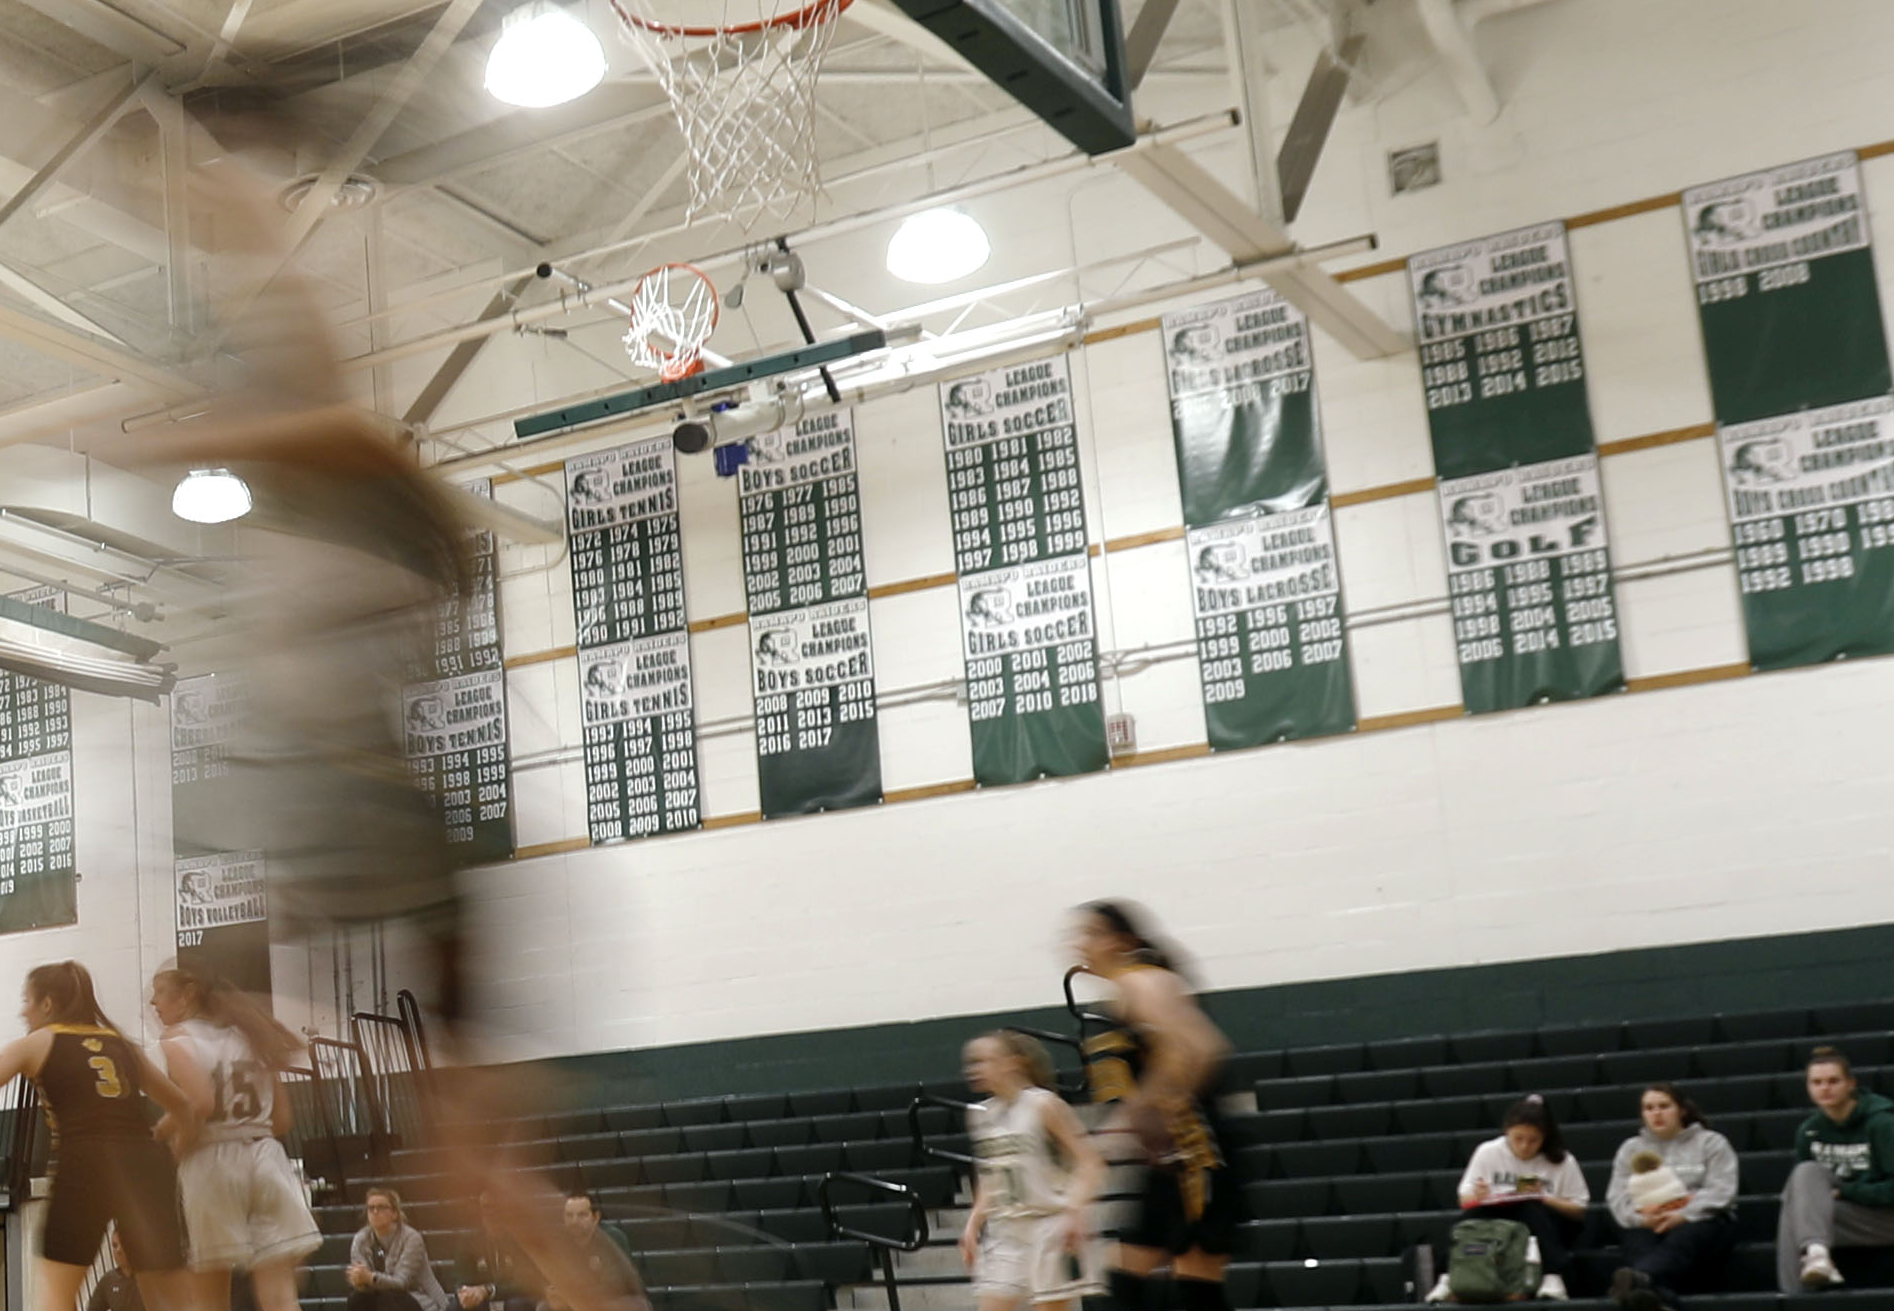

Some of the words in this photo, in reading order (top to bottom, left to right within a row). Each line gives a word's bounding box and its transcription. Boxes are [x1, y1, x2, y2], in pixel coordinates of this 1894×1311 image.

[1422, 283, 1567, 339] GYMNASTICS
[1006, 363, 1052, 388] LEAGUE
[996, 378, 1066, 408] CHAMPIONS
[796, 413, 837, 436] LEAGUE
[948, 422, 998, 445] GIRLS
[1004, 398, 1067, 433] SOCCER
[787, 428, 850, 456] CHAMPIONS
[992, 438, 1028, 460] 1981
[1037, 428, 1073, 450] 1982
[622, 455, 661, 476] LEAGUE
[743, 468, 784, 491] BOYS
[791, 447, 851, 481] SOCCER
[950, 468, 984, 490] 1983
[994, 458, 1030, 480] 1984
[613, 469, 673, 495] CHAMPIONS
[782, 484, 814, 505] 1977
[571, 507, 615, 530] GIRLS
[620, 488, 674, 521] TENNIS
[784, 504, 816, 525] 1989
[824, 495, 856, 516] 1990
[572, 532, 601, 551] 1972
[610, 524, 639, 543] 1974
[647, 516, 676, 535] 1975
[745, 532, 777, 553] 1991
[1262, 528, 1315, 551] LEAGUE
[1450, 516, 1598, 565] GOLF
[611, 543, 640, 562] 1978
[1251, 544, 1331, 573] CHAMPIONS
[1027, 575, 1075, 597] LEAGUE
[1197, 588, 1240, 612] BOYS
[1247, 564, 1331, 603] LACROSSE
[1016, 592, 1088, 618] CHAMPIONS
[1197, 615, 1237, 638] 1992
[1297, 597, 1336, 620] 1997
[812, 617, 856, 638] LEAGUE
[968, 629, 1019, 654] GIRLS
[1025, 610, 1088, 645] SOCCER
[802, 632, 867, 658] CHAMPIONS
[636, 650, 676, 670] LEAGUE
[758, 668, 799, 691] BOYS
[806, 651, 868, 683] SOCCER
[968, 657, 1002, 679] 2000
[1012, 649, 1047, 671] 2001
[1057, 641, 1092, 663] 2002
[1202, 658, 1242, 681] 2003
[1301, 640, 1343, 665] 2007
[627, 665, 687, 690] CHAMPIONS
[969, 677, 1004, 700] 2003
[16, 689, 37, 706] 1983
[455, 687, 492, 707] LEAGUE
[586, 701, 628, 722] GIRLS
[633, 683, 688, 715] TENNIS
[447, 701, 502, 725] CHAMPIONS
[758, 714, 789, 735] 2011
[798, 707, 831, 728] 2013
[840, 700, 874, 722] 2015
[407, 733, 445, 755] BOYS
[449, 718, 502, 748] TENNIS
[585, 725, 614, 745] 1993
[623, 718, 653, 737] 1994
[661, 710, 691, 730] 1995
[442, 752, 470, 770] 1994
[476, 746, 504, 764] 1995
[586, 744, 616, 764] 1996
[759, 734, 791, 756] 2016
[32, 767, 61, 784] LEAGUE
[443, 771, 470, 789] 1998
[477, 764, 505, 783] 1999
[24, 780, 69, 800] CHAMPIONS
[19, 825, 43, 842] 1999
[49, 820, 71, 836] 2000
[20, 842, 43, 858] 2002
[180, 903, 204, 928] BOYS
[178, 931, 203, 947] 2017
[88, 1056, 122, 1098] 3
